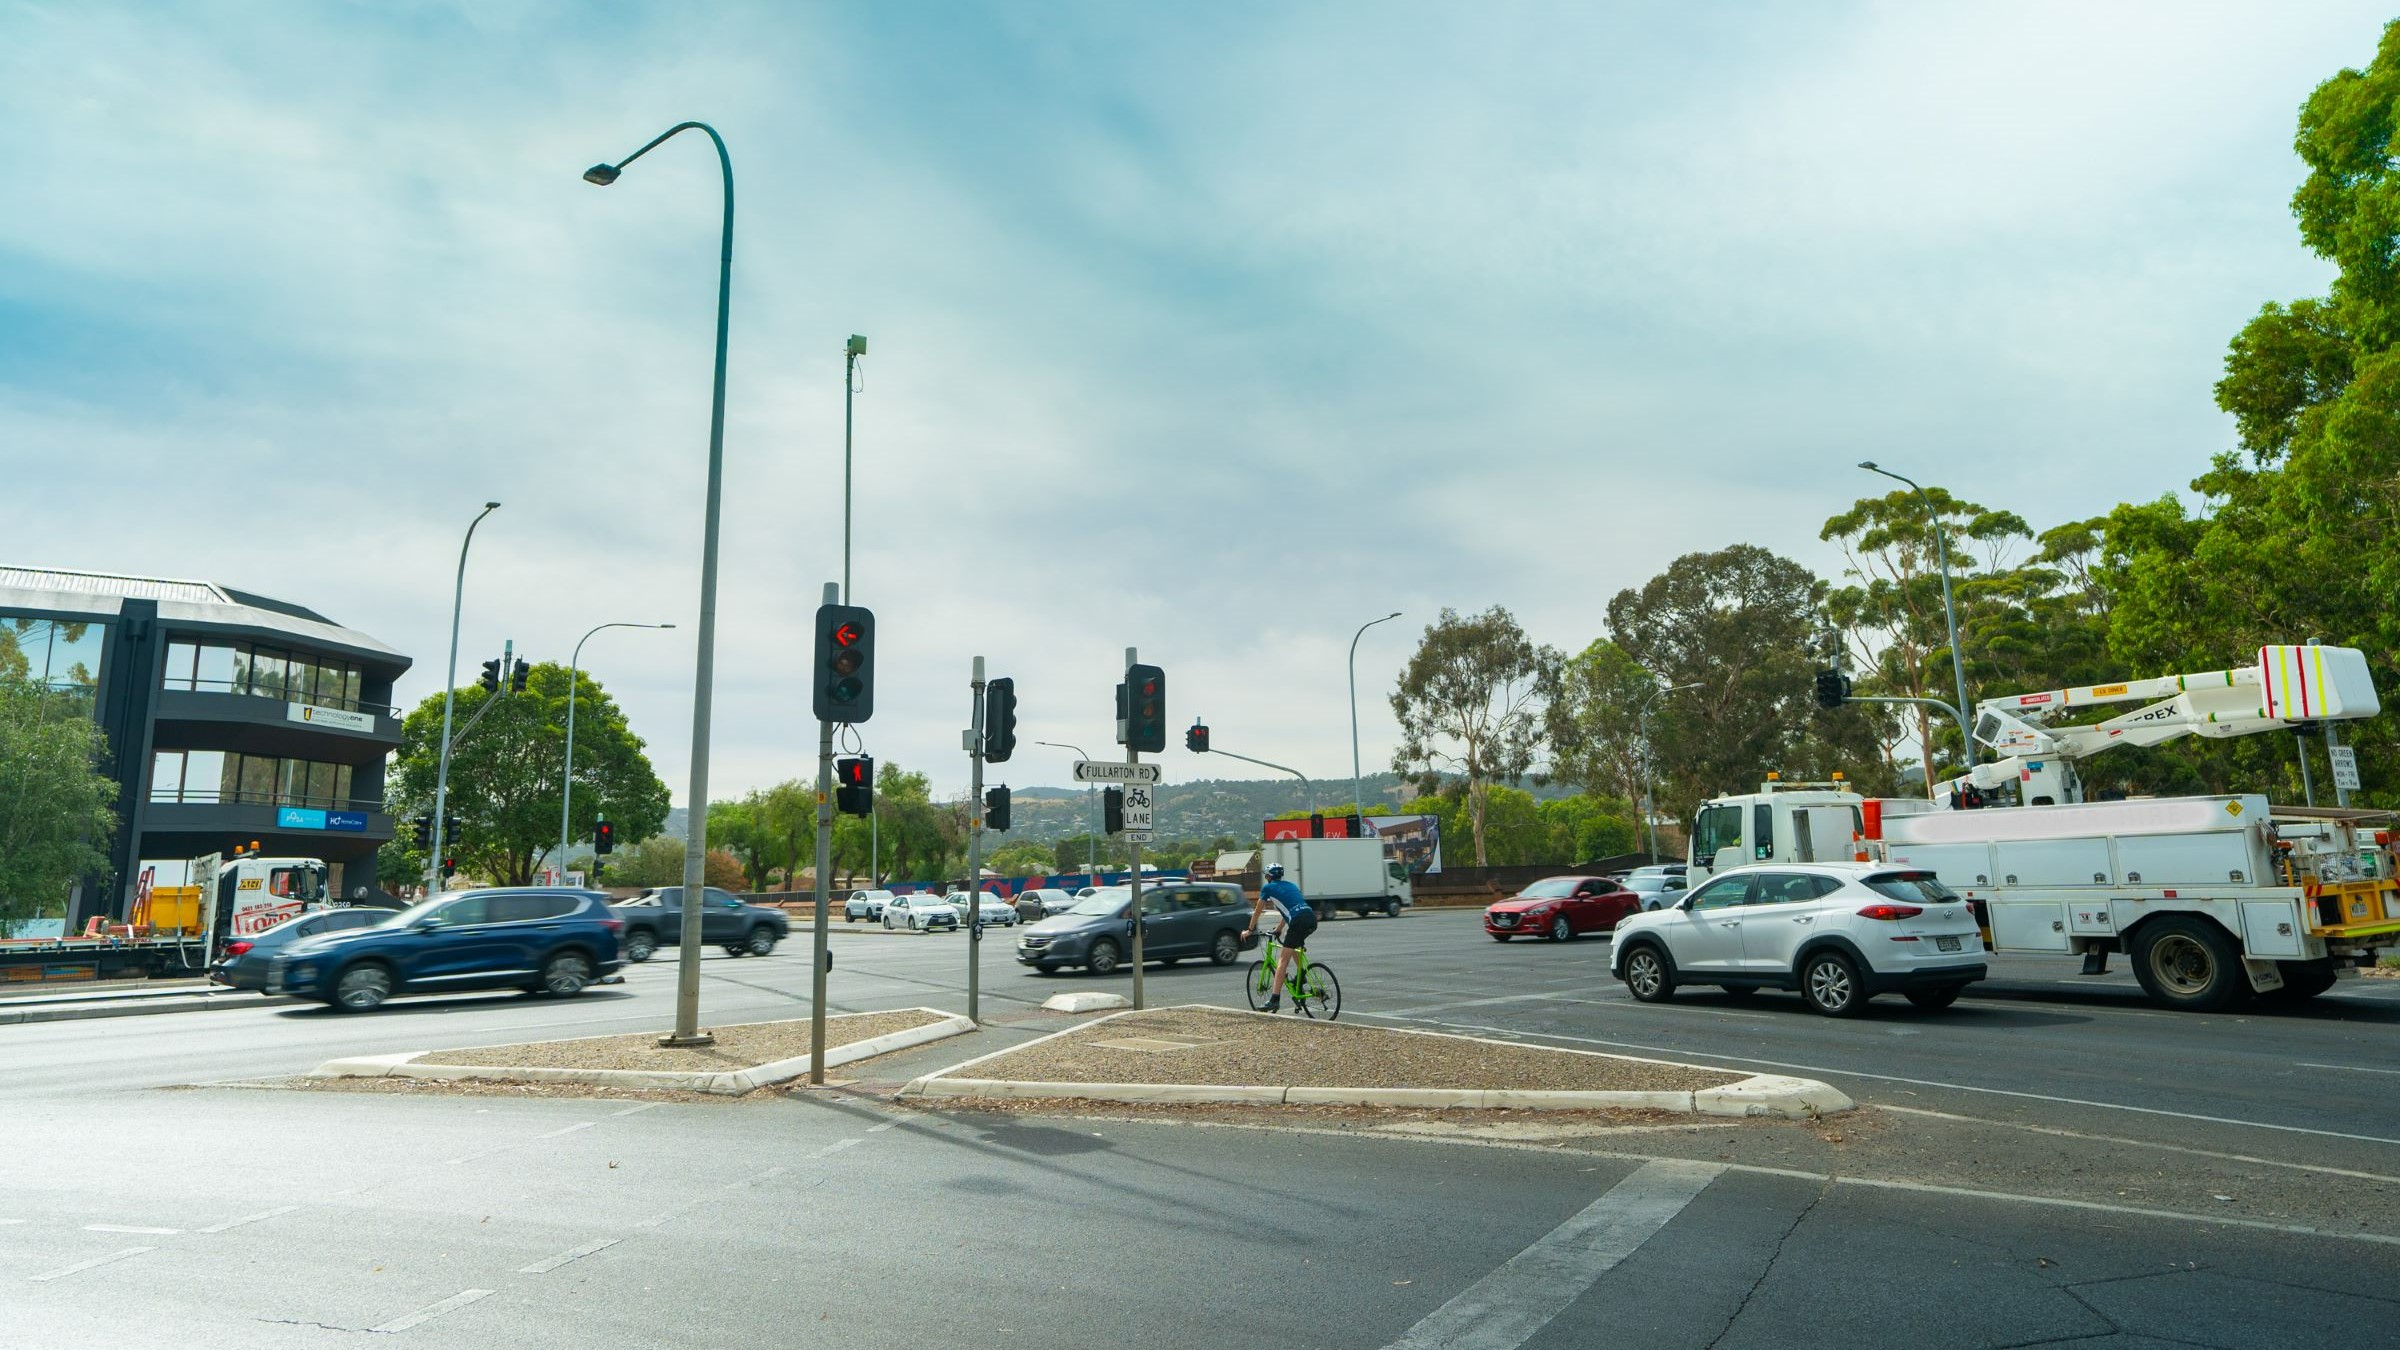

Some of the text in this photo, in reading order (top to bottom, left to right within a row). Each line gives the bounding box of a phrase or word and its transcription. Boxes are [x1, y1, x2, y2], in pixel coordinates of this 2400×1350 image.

[2127, 704, 2178, 722] REX
[1086, 765, 1150, 779] FULLARTON RD
[1126, 812, 1151, 824] LANE
[1130, 833, 1147, 841] END
